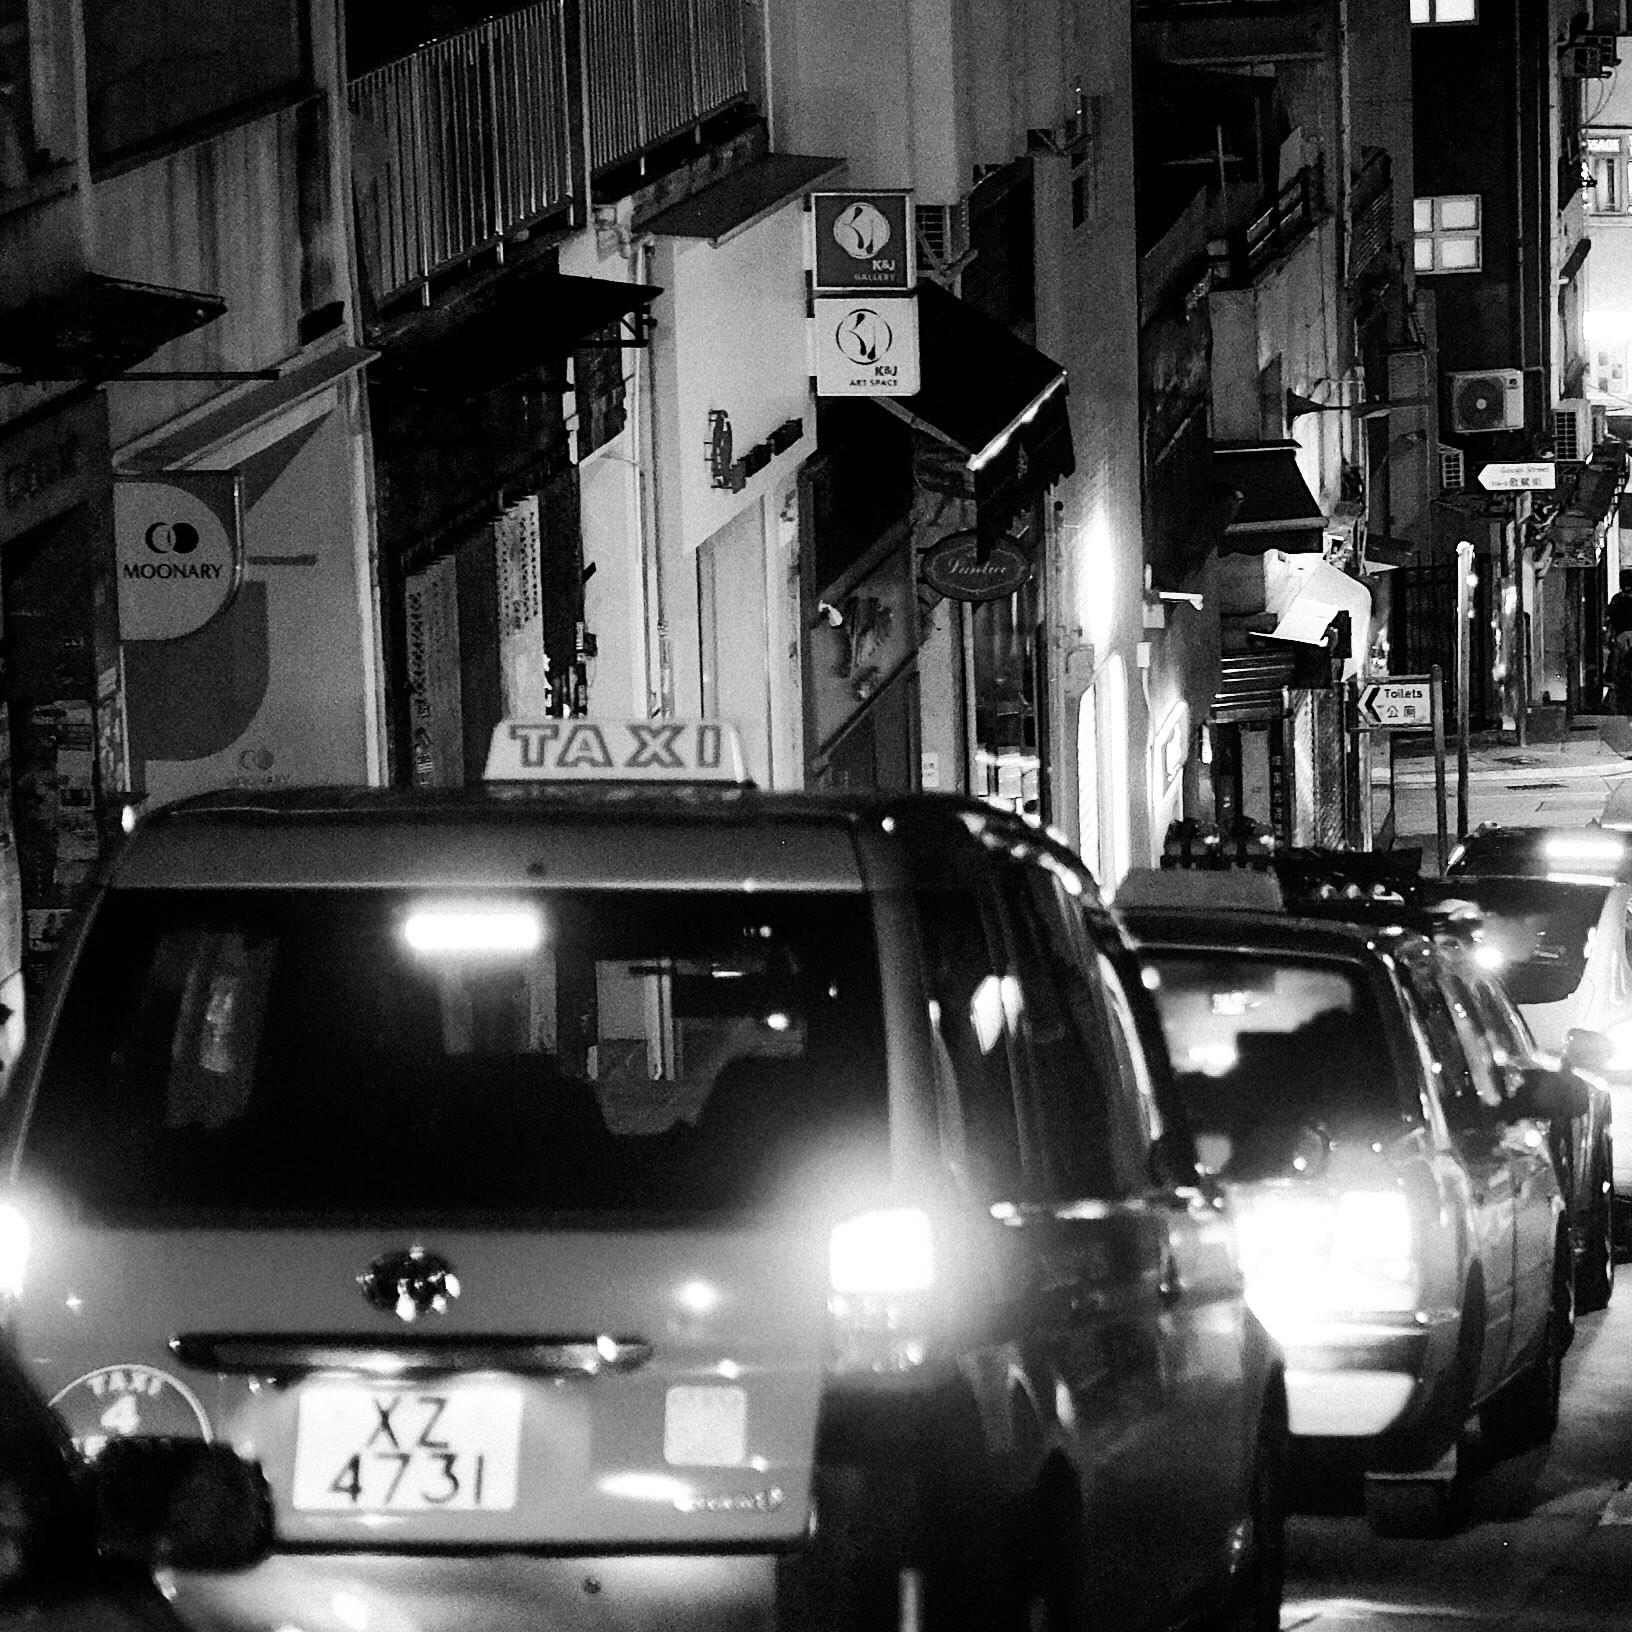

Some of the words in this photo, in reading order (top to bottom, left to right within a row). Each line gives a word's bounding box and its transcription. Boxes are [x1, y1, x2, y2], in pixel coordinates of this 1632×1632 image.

[874, 365, 898, 377] K&J
[848, 379, 867, 387] ART
[869, 379, 898, 387] SPACE
[122, 563, 222, 579] MOONARY
[1384, 688, 1423, 699] Toilets
[510, 723, 721, 768] TAXI
[366, 1395, 449, 1449] XZ
[328, 1452, 484, 1505] 4731
